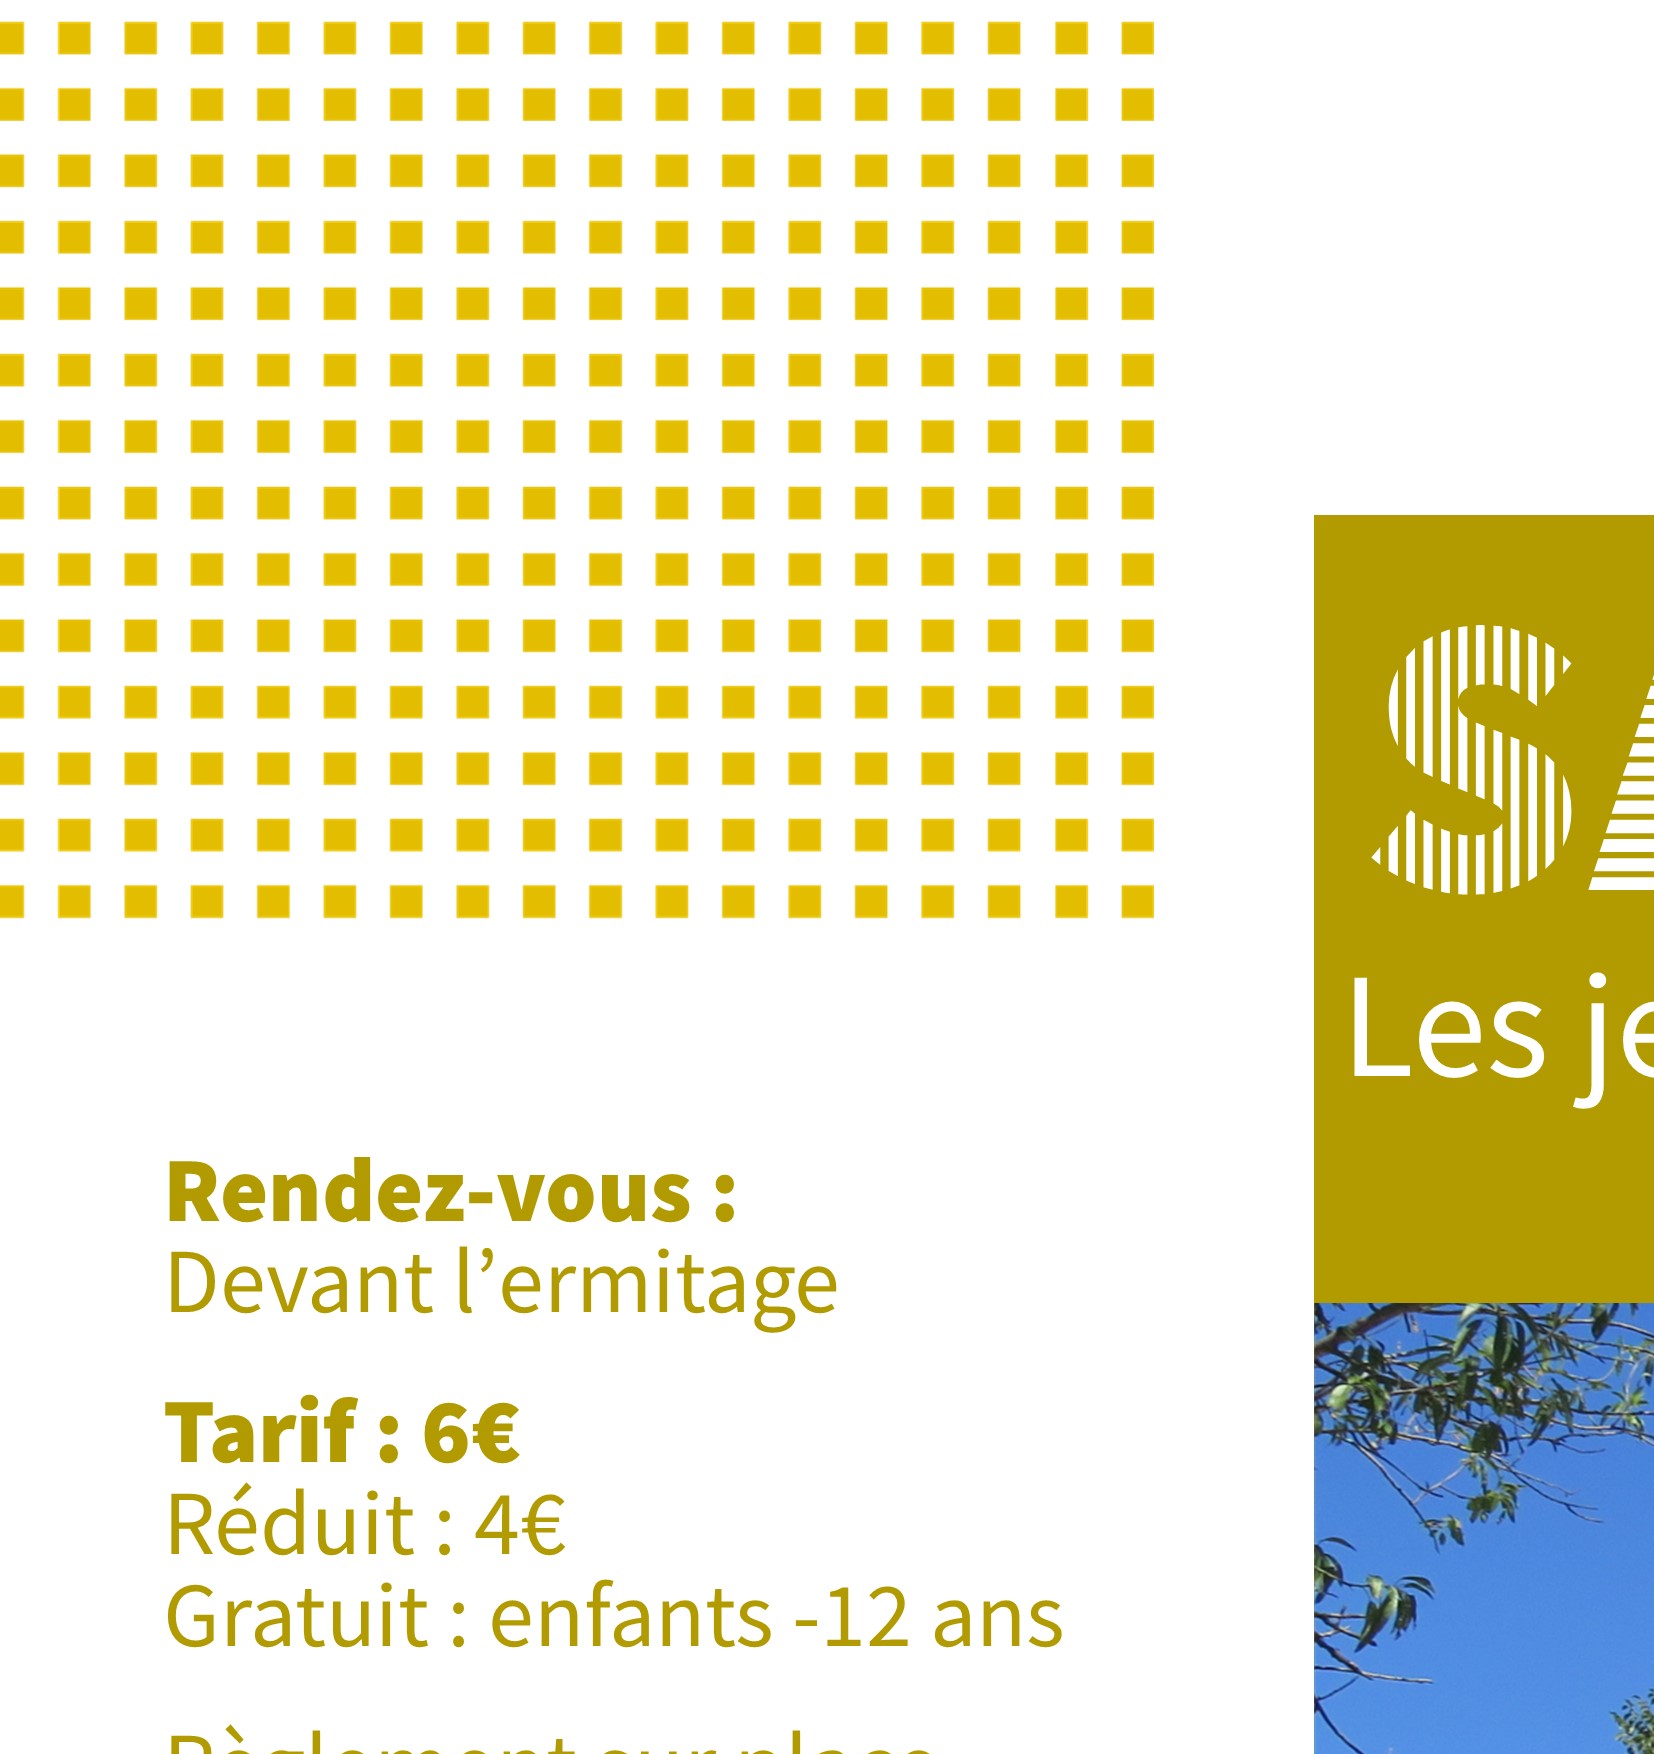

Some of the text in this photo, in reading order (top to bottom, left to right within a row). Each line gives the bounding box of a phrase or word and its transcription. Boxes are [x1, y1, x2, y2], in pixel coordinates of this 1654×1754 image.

[1354, 977, 1544, 1078] Les
[169, 1157, 690, 1223] Rendez-vous
[171, 1246, 837, 1333] Devant l’ermitage
[165, 1394, 358, 1464] Tarif
[424, 1402, 520, 1464] 6€
[171, 1482, 414, 1556] Réduit
[475, 1494, 565, 1556] 4€
[168, 1582, 428, 1648] Gratuit
[492, 1579, 771, 1648] enfants
[796, 1586, 908, 1646] -12
[934, 1600, 1062, 1648] ans
